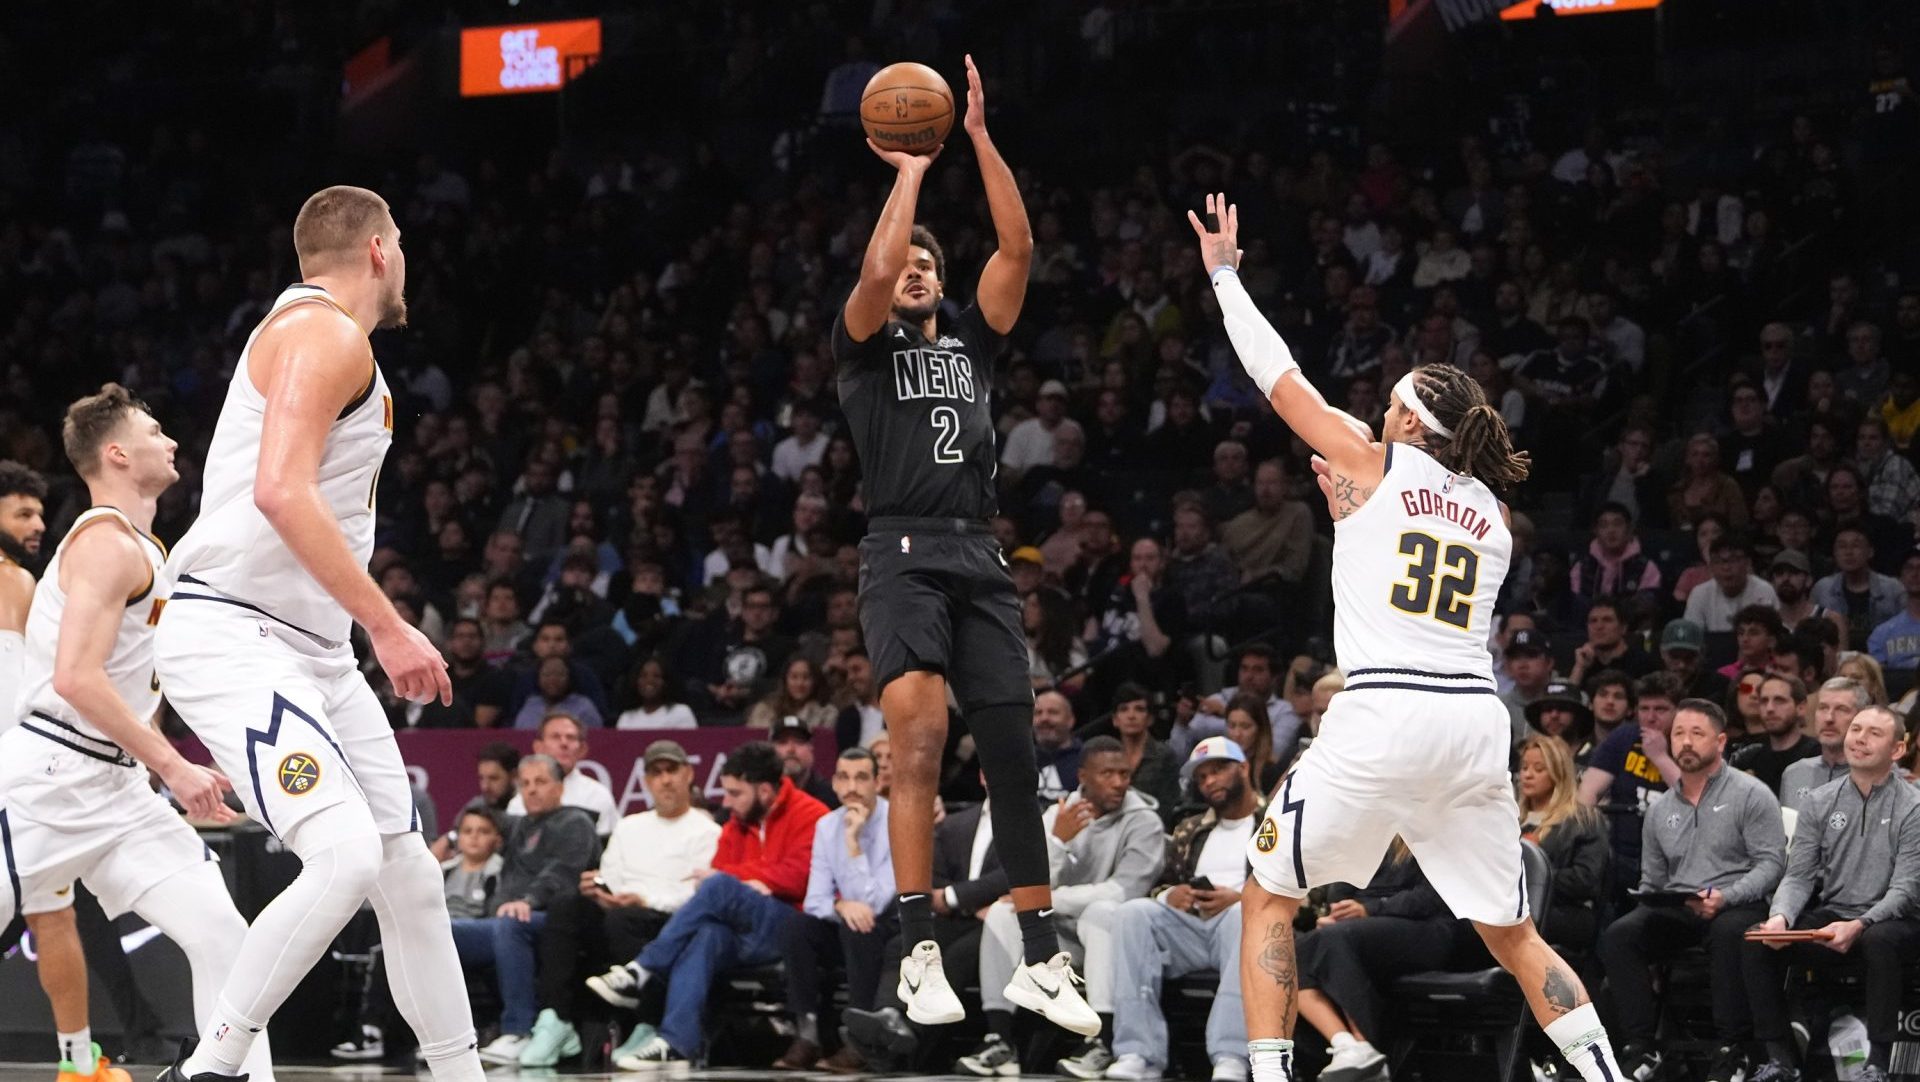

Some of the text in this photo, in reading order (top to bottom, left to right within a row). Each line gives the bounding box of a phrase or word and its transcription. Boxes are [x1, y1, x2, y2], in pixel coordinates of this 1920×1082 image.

[500, 30, 538, 52] GET
[502, 47, 557, 69] YOUR
[500, 64, 559, 88] GUIDE
[893, 349, 975, 403] NETS
[931, 406, 964, 463] 2
[1401, 488, 1491, 541] GORDON
[1389, 530, 1481, 632] 32
